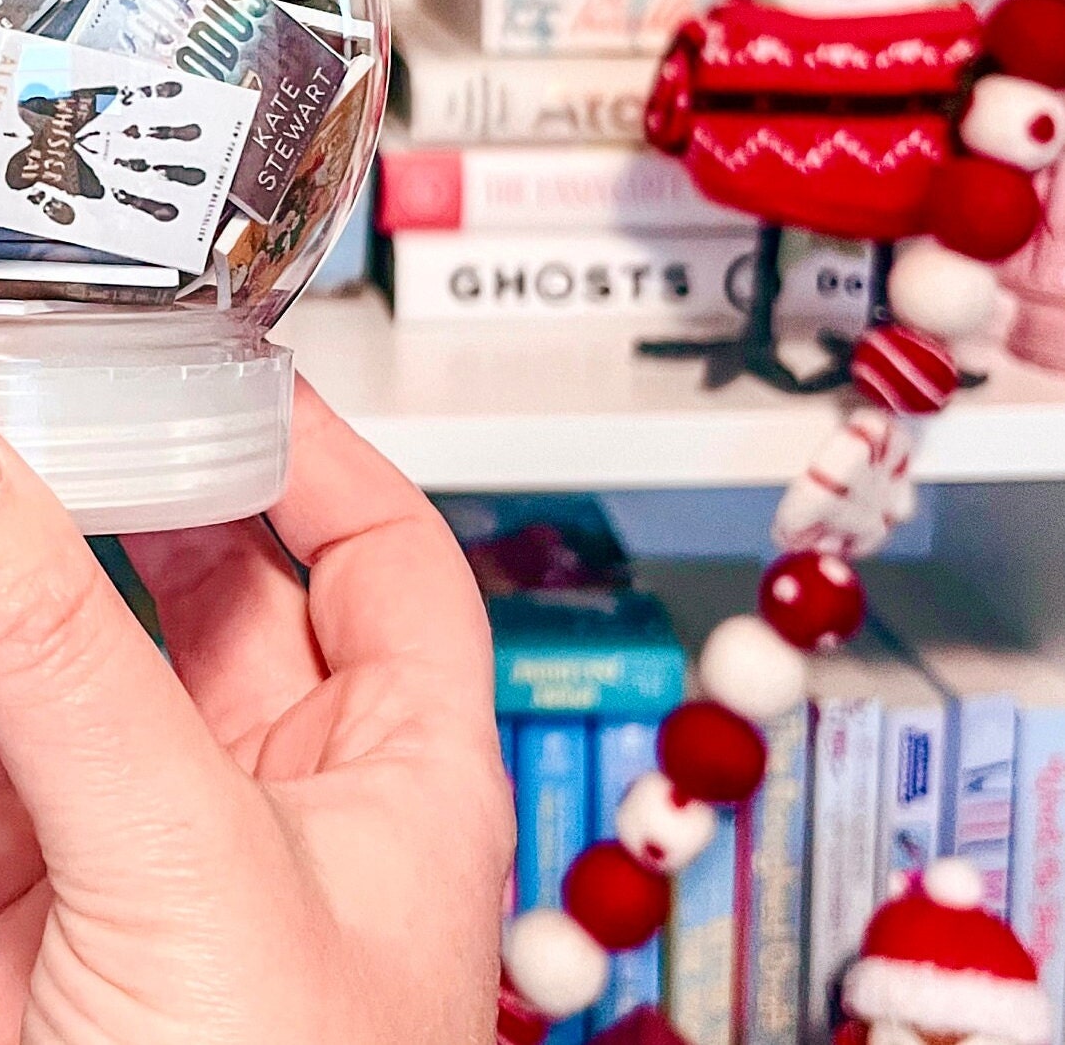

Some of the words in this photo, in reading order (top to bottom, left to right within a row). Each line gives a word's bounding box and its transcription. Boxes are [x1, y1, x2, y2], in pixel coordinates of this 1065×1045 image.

[251, 76, 302, 150] KATE
[257, 67, 332, 191] STEWART
[448, 262, 692, 303] GHOSTS
